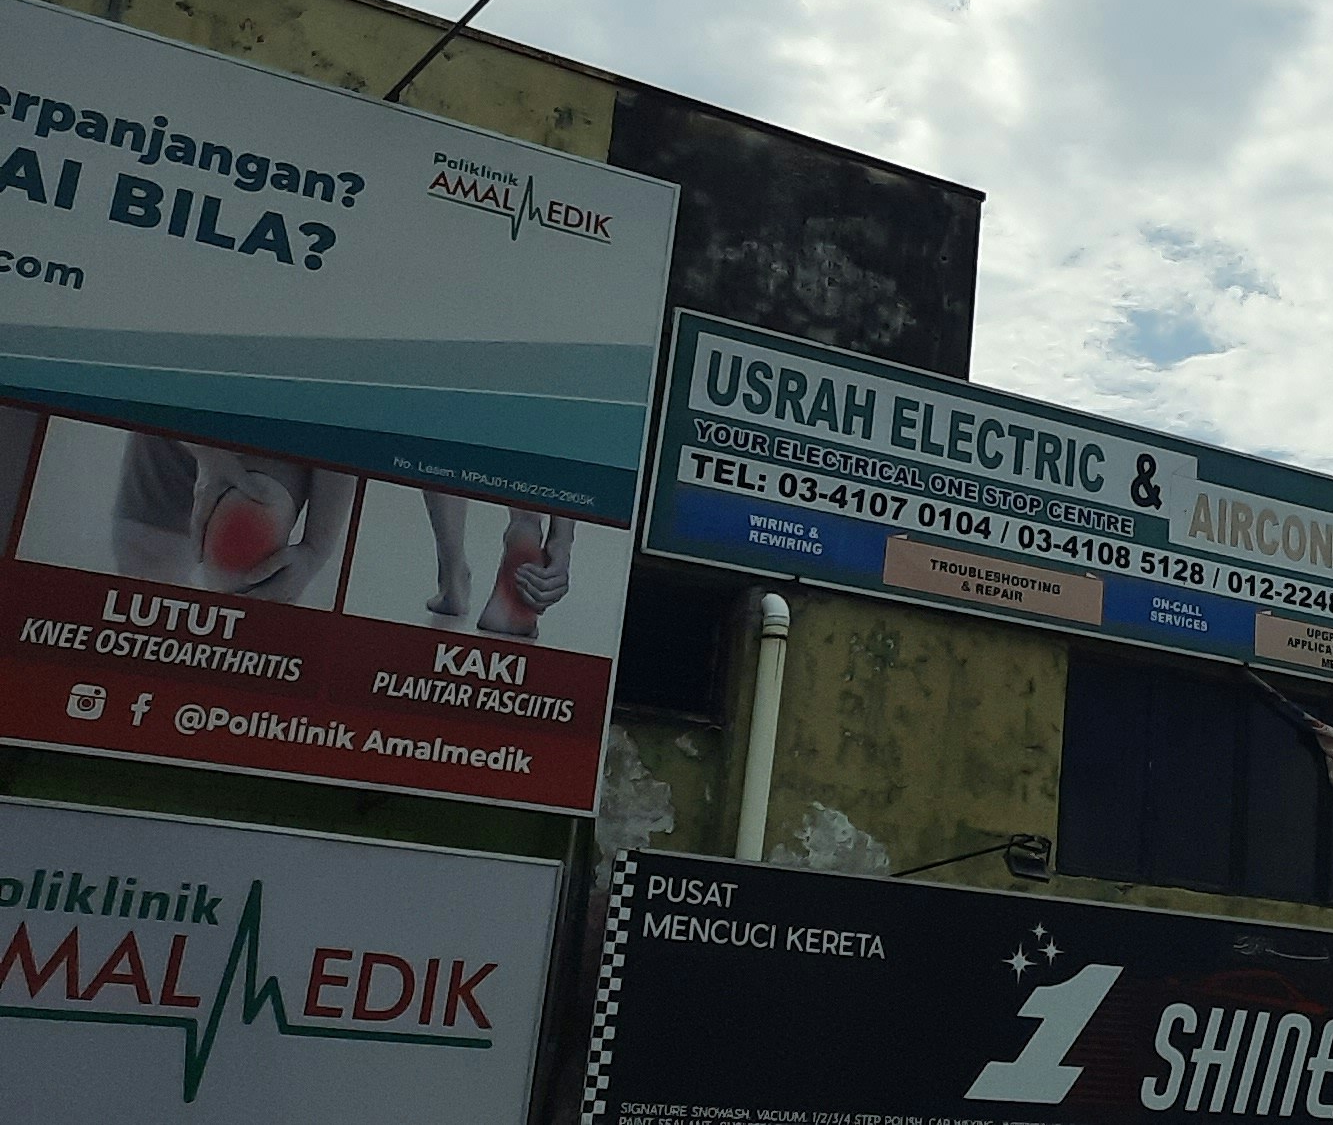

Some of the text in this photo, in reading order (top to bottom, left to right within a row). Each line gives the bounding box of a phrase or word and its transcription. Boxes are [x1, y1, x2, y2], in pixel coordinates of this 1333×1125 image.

[434, 152, 518, 186] Poliklinik
[109, 172, 337, 271] BILA?
[705, 350, 1163, 510] USRAH ELECTRIC &
[694, 419, 1135, 537] YOUR ELECTRICAL ONE STOP CENTRE
[691, 453, 767, 493] TEL:
[778, 472, 909, 522] 03-4107
[918, 504, 992, 540] 0104
[1000, 521, 1010, 545] /
[1017, 524, 1131, 569] 03-4108
[1140, 556, 1205, 586] 5128
[1211, 567, 1221, 590] /
[747, 513, 820, 540] WIRING &
[748, 530, 824, 556] REWIRING
[929, 558, 1061, 596] TROUBLESHOOTING
[960, 579, 1024, 604] & REPAIR
[102, 590, 246, 639] LUTUT
[1150, 610, 1208, 632] SERVICES
[1152, 597, 1203, 616] ON-CALL
[20, 616, 303, 683] KNEE OSTEOARTHRITIS
[432, 643, 528, 686] KAKI
[372, 671, 474, 709] PLANTAR
[174, 705, 533, 775] @Poliklinik Amalmedik
[647, 875, 738, 908] PUSAT
[642, 912, 886, 960] MENCUCI KERETA
[963, 963, 1125, 1104] 1
[620, 1102, 688, 1117] SIGNATURE
